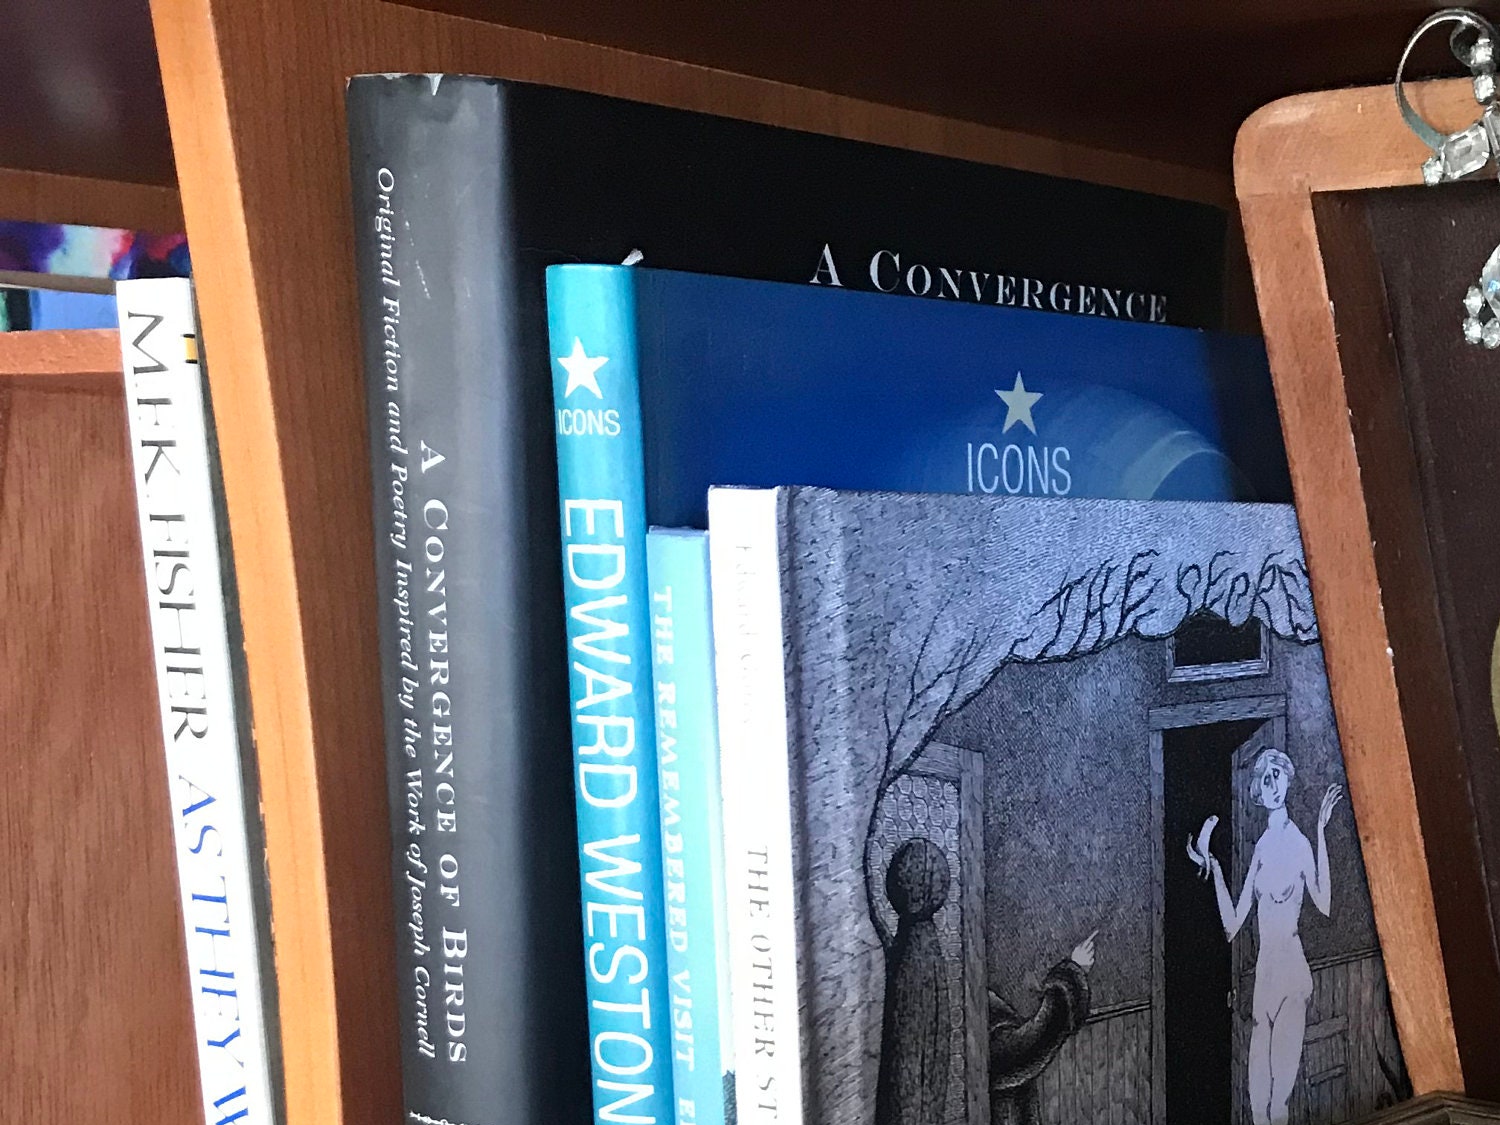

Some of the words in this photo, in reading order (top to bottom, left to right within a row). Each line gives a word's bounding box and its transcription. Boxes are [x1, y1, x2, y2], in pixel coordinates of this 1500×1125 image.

[374, 167, 401, 287] Original
[808, 243, 843, 288] A
[868, 248, 1169, 323] CONVERGENCE
[382, 296, 402, 392] Fiction
[387, 401, 409, 455] and
[420, 439, 447, 475] A
[557, 408, 621, 437] ICONS
[389, 463, 408, 549] Poetry
[966, 441, 1072, 497] ICONS
[149, 513, 209, 743] FISHER
[393, 559, 420, 671] Inspired
[563, 498, 638, 809] EDWARD
[653, 585, 674, 665] THE
[397, 676, 420, 709] by
[422, 498, 458, 833] CONVERGENCE
[402, 716, 422, 758] the
[178, 774, 224, 857] AS
[406, 769, 427, 835] Work
[657, 680, 689, 953] REMEMBERED
[405, 842, 428, 874] of
[438, 853, 461, 907] OF
[747, 846, 769, 919] THE
[406, 869, 432, 957] Joseph
[191, 875, 245, 1069] THEY
[413, 965, 436, 1058] Cornell
[441, 927, 468, 1063] BIRDS
[582, 833, 657, 1125] WESTON
[750, 933, 775, 1059] OTHER
[671, 968, 696, 1072] VISIT
